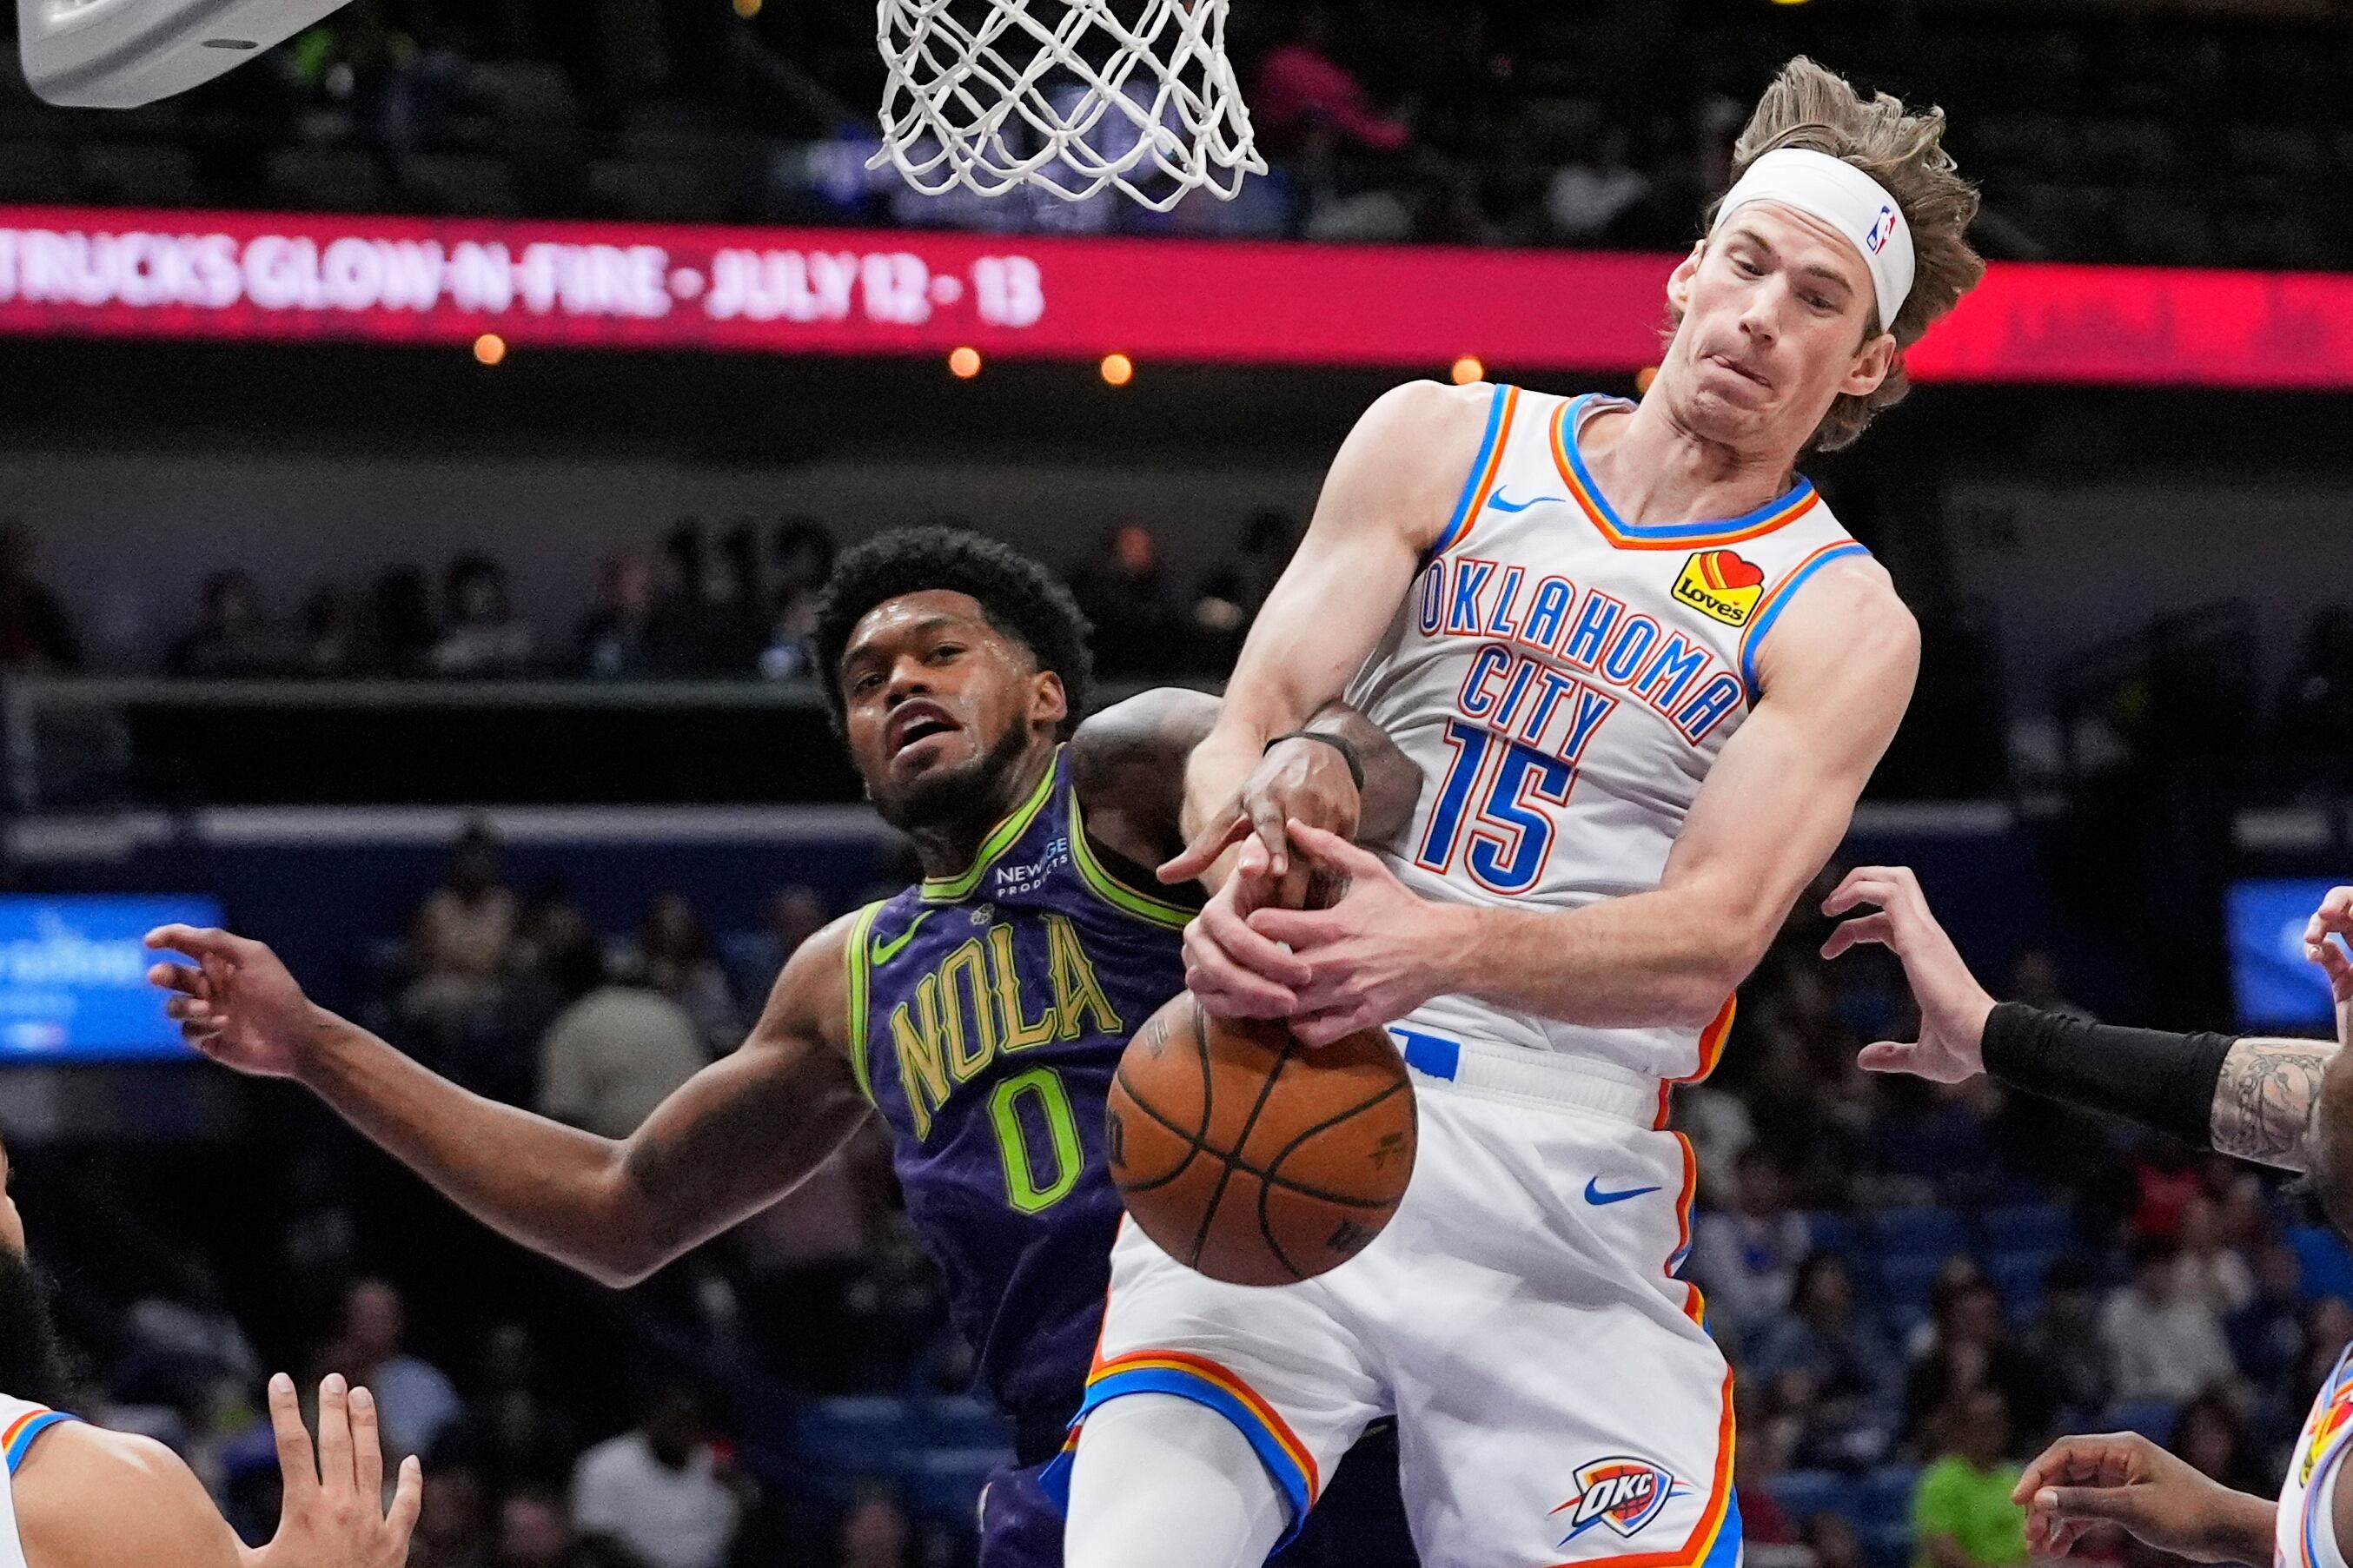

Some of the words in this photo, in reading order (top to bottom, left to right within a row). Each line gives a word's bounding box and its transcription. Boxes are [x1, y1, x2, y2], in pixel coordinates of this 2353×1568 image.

[703, 248, 858, 321] JULY
[973, 255, 1044, 327] 13
[1419, 557, 1745, 746] OKLAHOMA
[1459, 644, 1620, 764] CITY
[996, 837, 1068, 884] NEWGE
[1416, 717, 1579, 895] 15
[890, 914, 1123, 1142] NOLA
[989, 1066, 1084, 1214] 0
[1573, 1472, 1654, 1526] OKC
